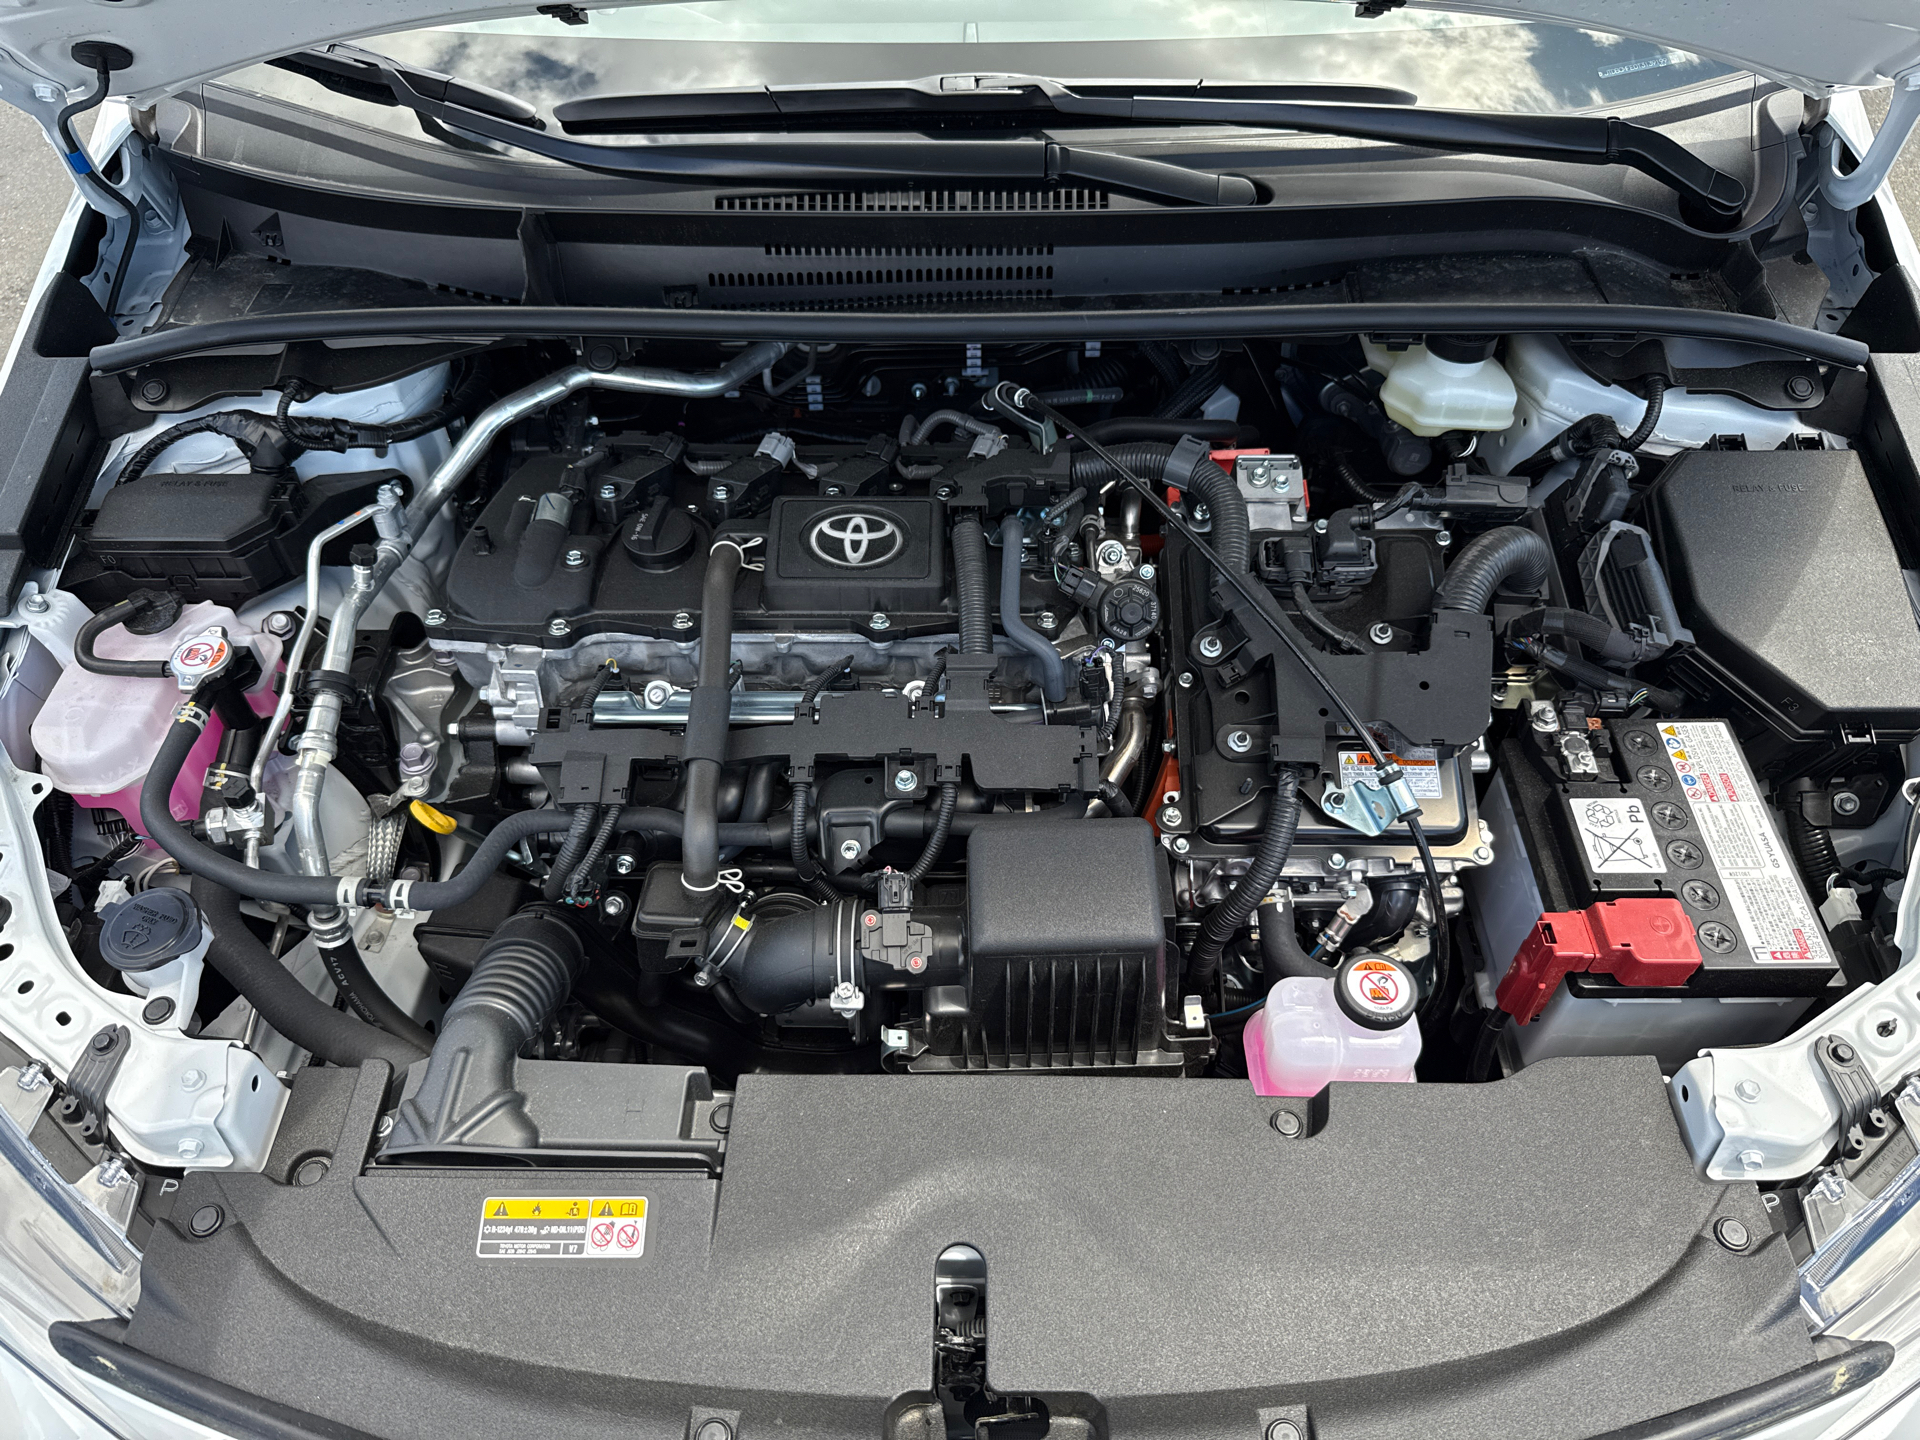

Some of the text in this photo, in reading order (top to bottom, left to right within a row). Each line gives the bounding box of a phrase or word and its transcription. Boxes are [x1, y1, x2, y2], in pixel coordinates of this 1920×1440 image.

[1732, 484, 1764, 493] RELAY
[1777, 483, 1805, 493] FUSE
[1780, 696, 1800, 712] F3
[1679, 725, 1706, 772] EXPLOSIVE GASES
[1698, 725, 1725, 772] CAUSES SEVERE BURNS
[1700, 774, 1716, 795] DANGER
[1719, 774, 1735, 795] POISON
[1626, 805, 1644, 823] Pb
[1757, 832, 1775, 857] YUASA
[1770, 858, 1780, 868] GS
[1798, 905, 1810, 919] CCA
[1793, 929, 1809, 951] DANGER
[1796, 916, 1821, 958] 345LN1-MF
[1806, 923, 1819, 939] 45Ah
[1814, 941, 1828, 958] 20HR
[329, 955, 377, 1022] YOKOHAMA ACV17
[1365, 1010, 1403, 1021] DENSO
[159, 1178, 179, 1196] P
[1761, 1193, 1780, 1213] P
[491, 1225, 513, 1235] R-1234yf
[569, 1244, 578, 1253] V7
